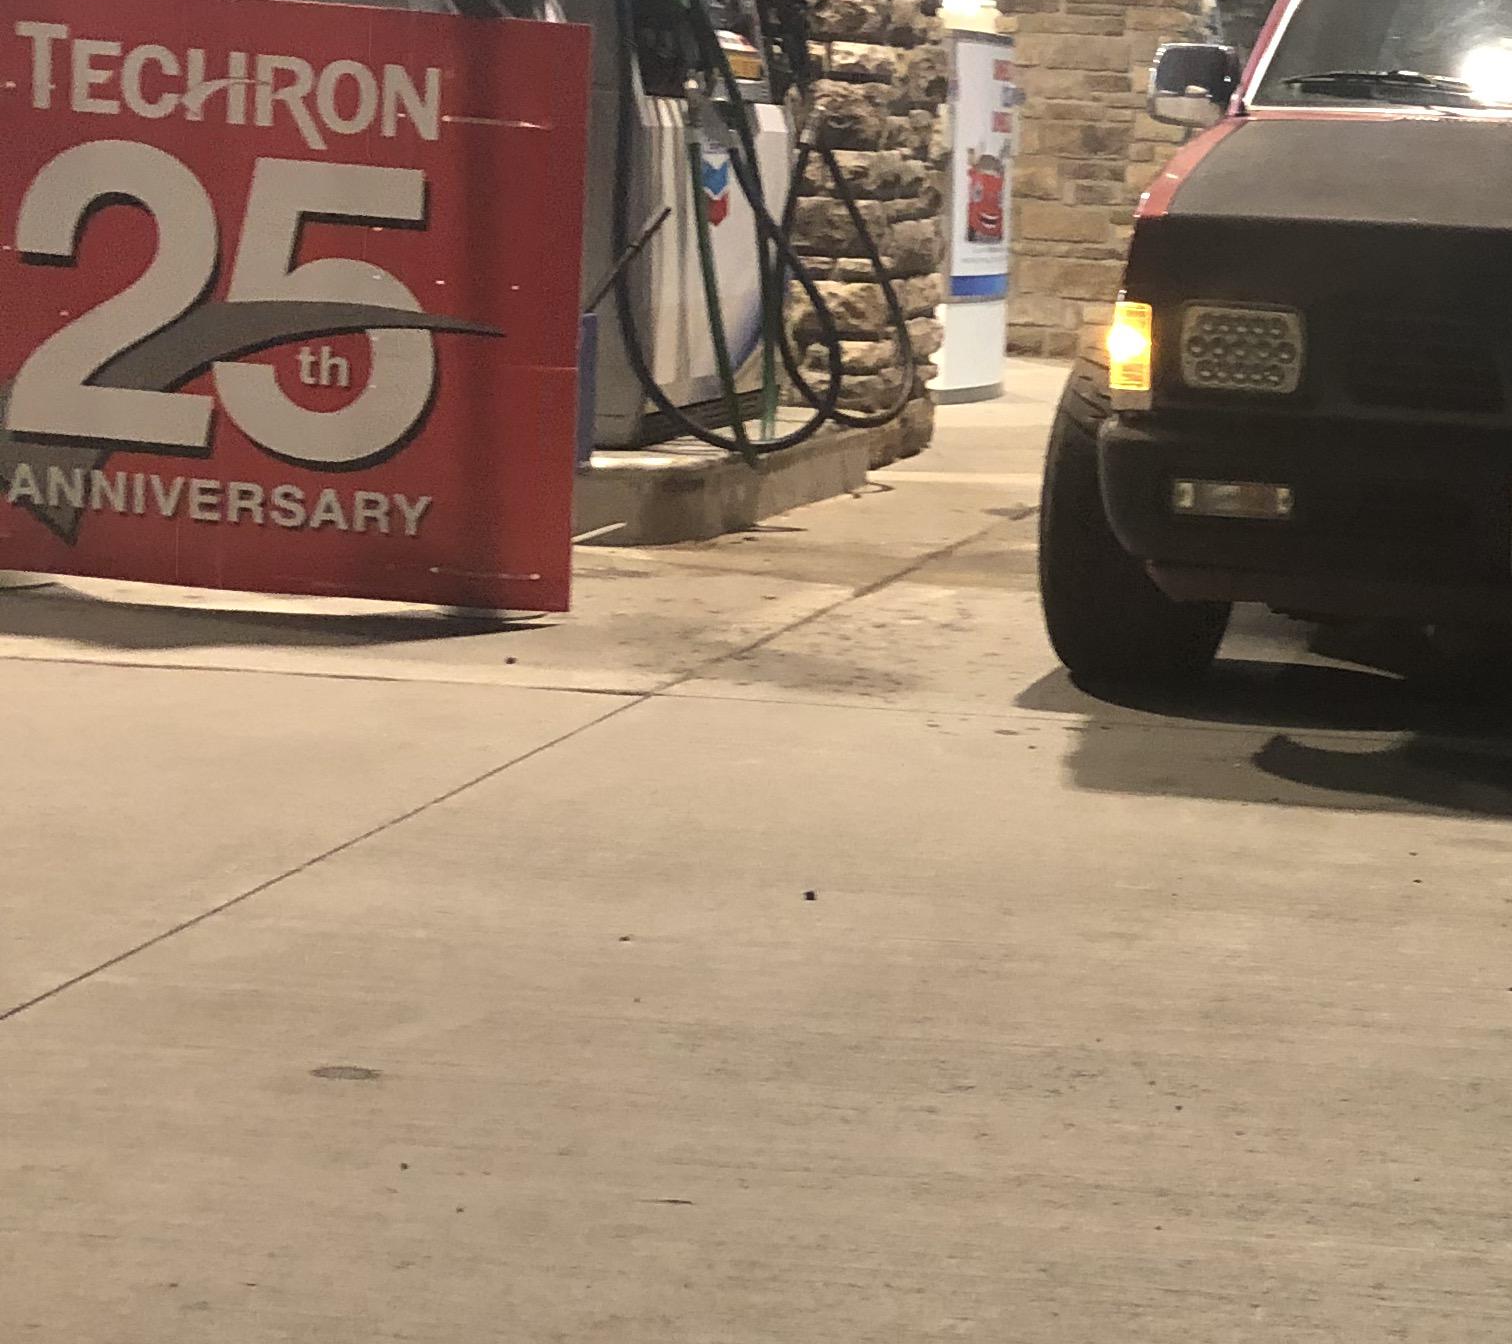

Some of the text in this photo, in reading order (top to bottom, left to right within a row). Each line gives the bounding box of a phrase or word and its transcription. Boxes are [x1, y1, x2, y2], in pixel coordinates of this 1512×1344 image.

[13, 20, 443, 150] TECHRON
[3, 138, 440, 472] 25 th
[5, 461, 434, 537] ANNIVERSARY
